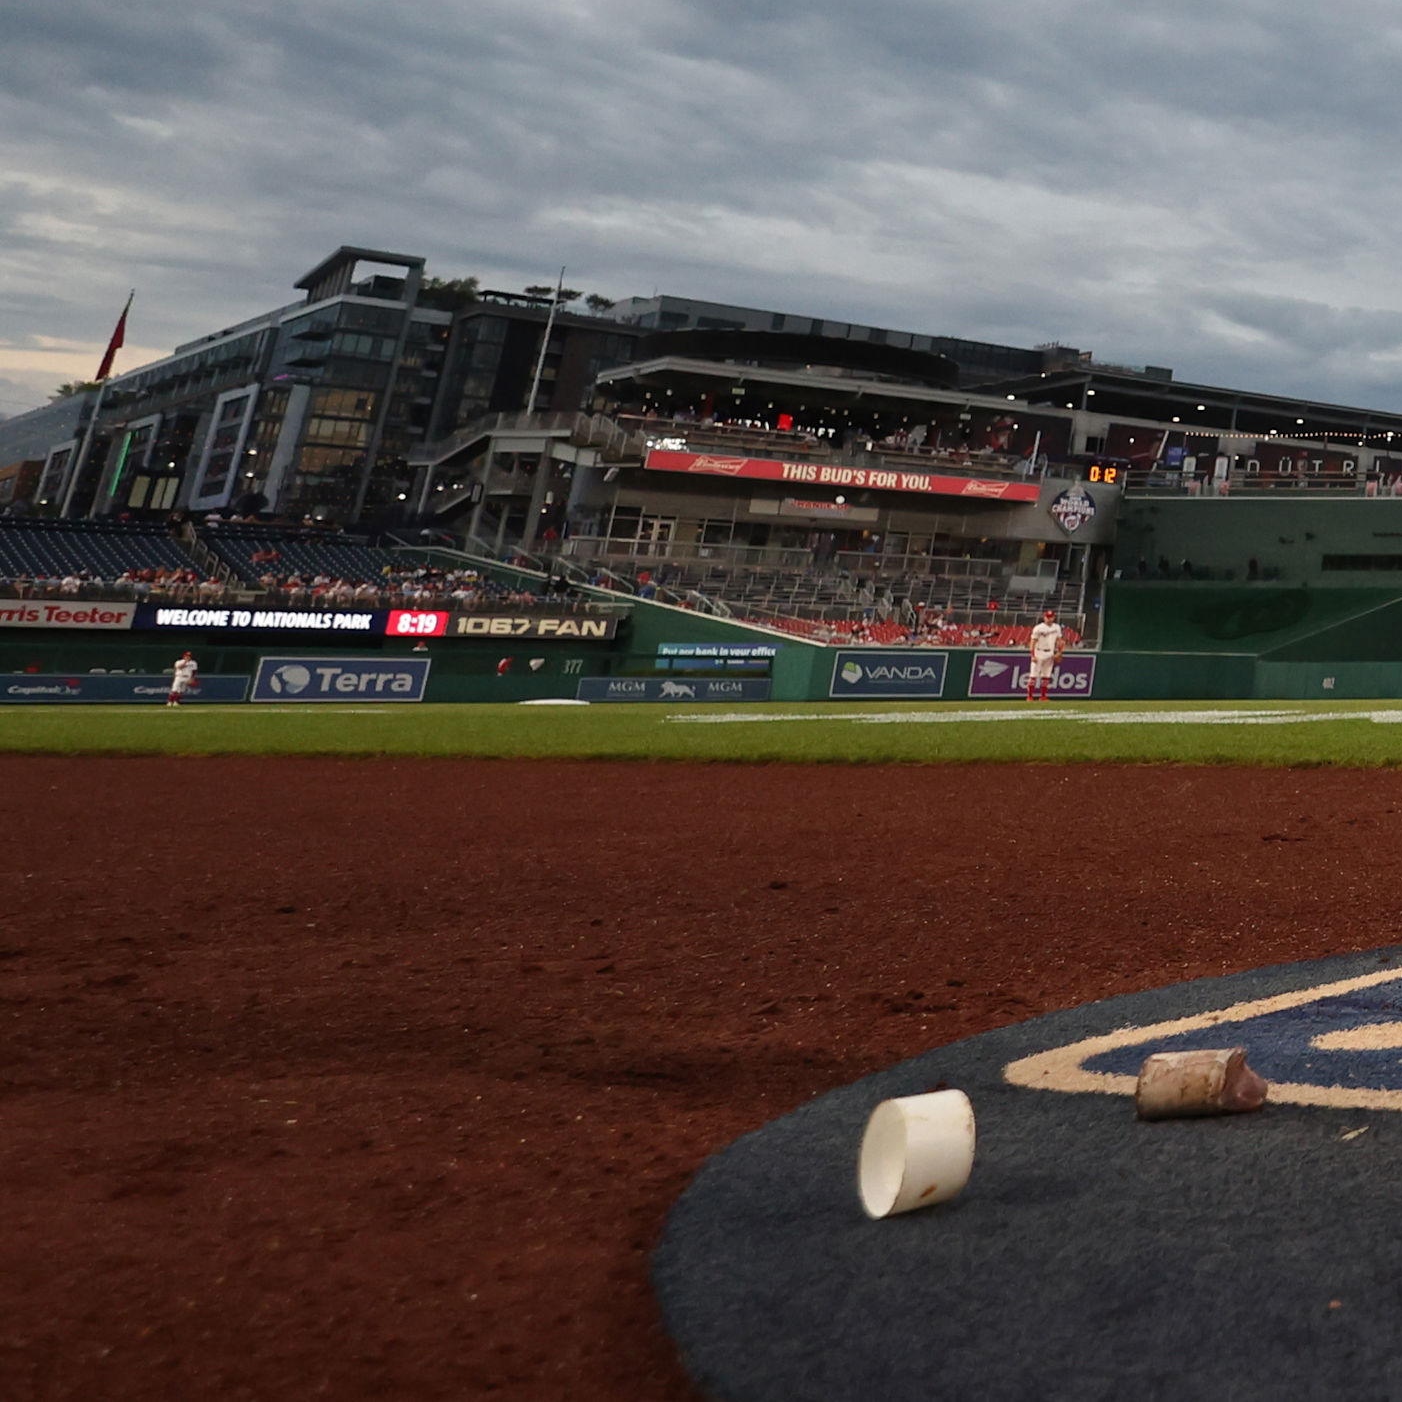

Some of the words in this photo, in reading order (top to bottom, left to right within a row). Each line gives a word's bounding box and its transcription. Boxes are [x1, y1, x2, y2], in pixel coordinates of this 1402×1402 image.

[782, 463, 817, 481] THIS
[820, 467, 866, 485] BUD'S
[868, 472, 897, 489] FOR
[901, 475, 932, 491] YOU.
[1089, 465, 1117, 484] 0:12
[43, 605, 128, 625] Teeter
[156, 608, 228, 627] WELCOME
[232, 610, 250, 627] TO
[251, 610, 332, 629] NATIONALS
[333, 612, 372, 630] PARK
[397, 613, 437, 634] 8:19
[537, 619, 607, 637] FAN
[662, 647, 678, 656] Put
[751, 647, 777, 656] office
[563, 659, 583, 675] 377
[865, 665, 937, 680] VANDA
[316, 667, 413, 692] Terra
[608, 681, 646, 692] MGM
[707, 681, 743, 692] MGM
